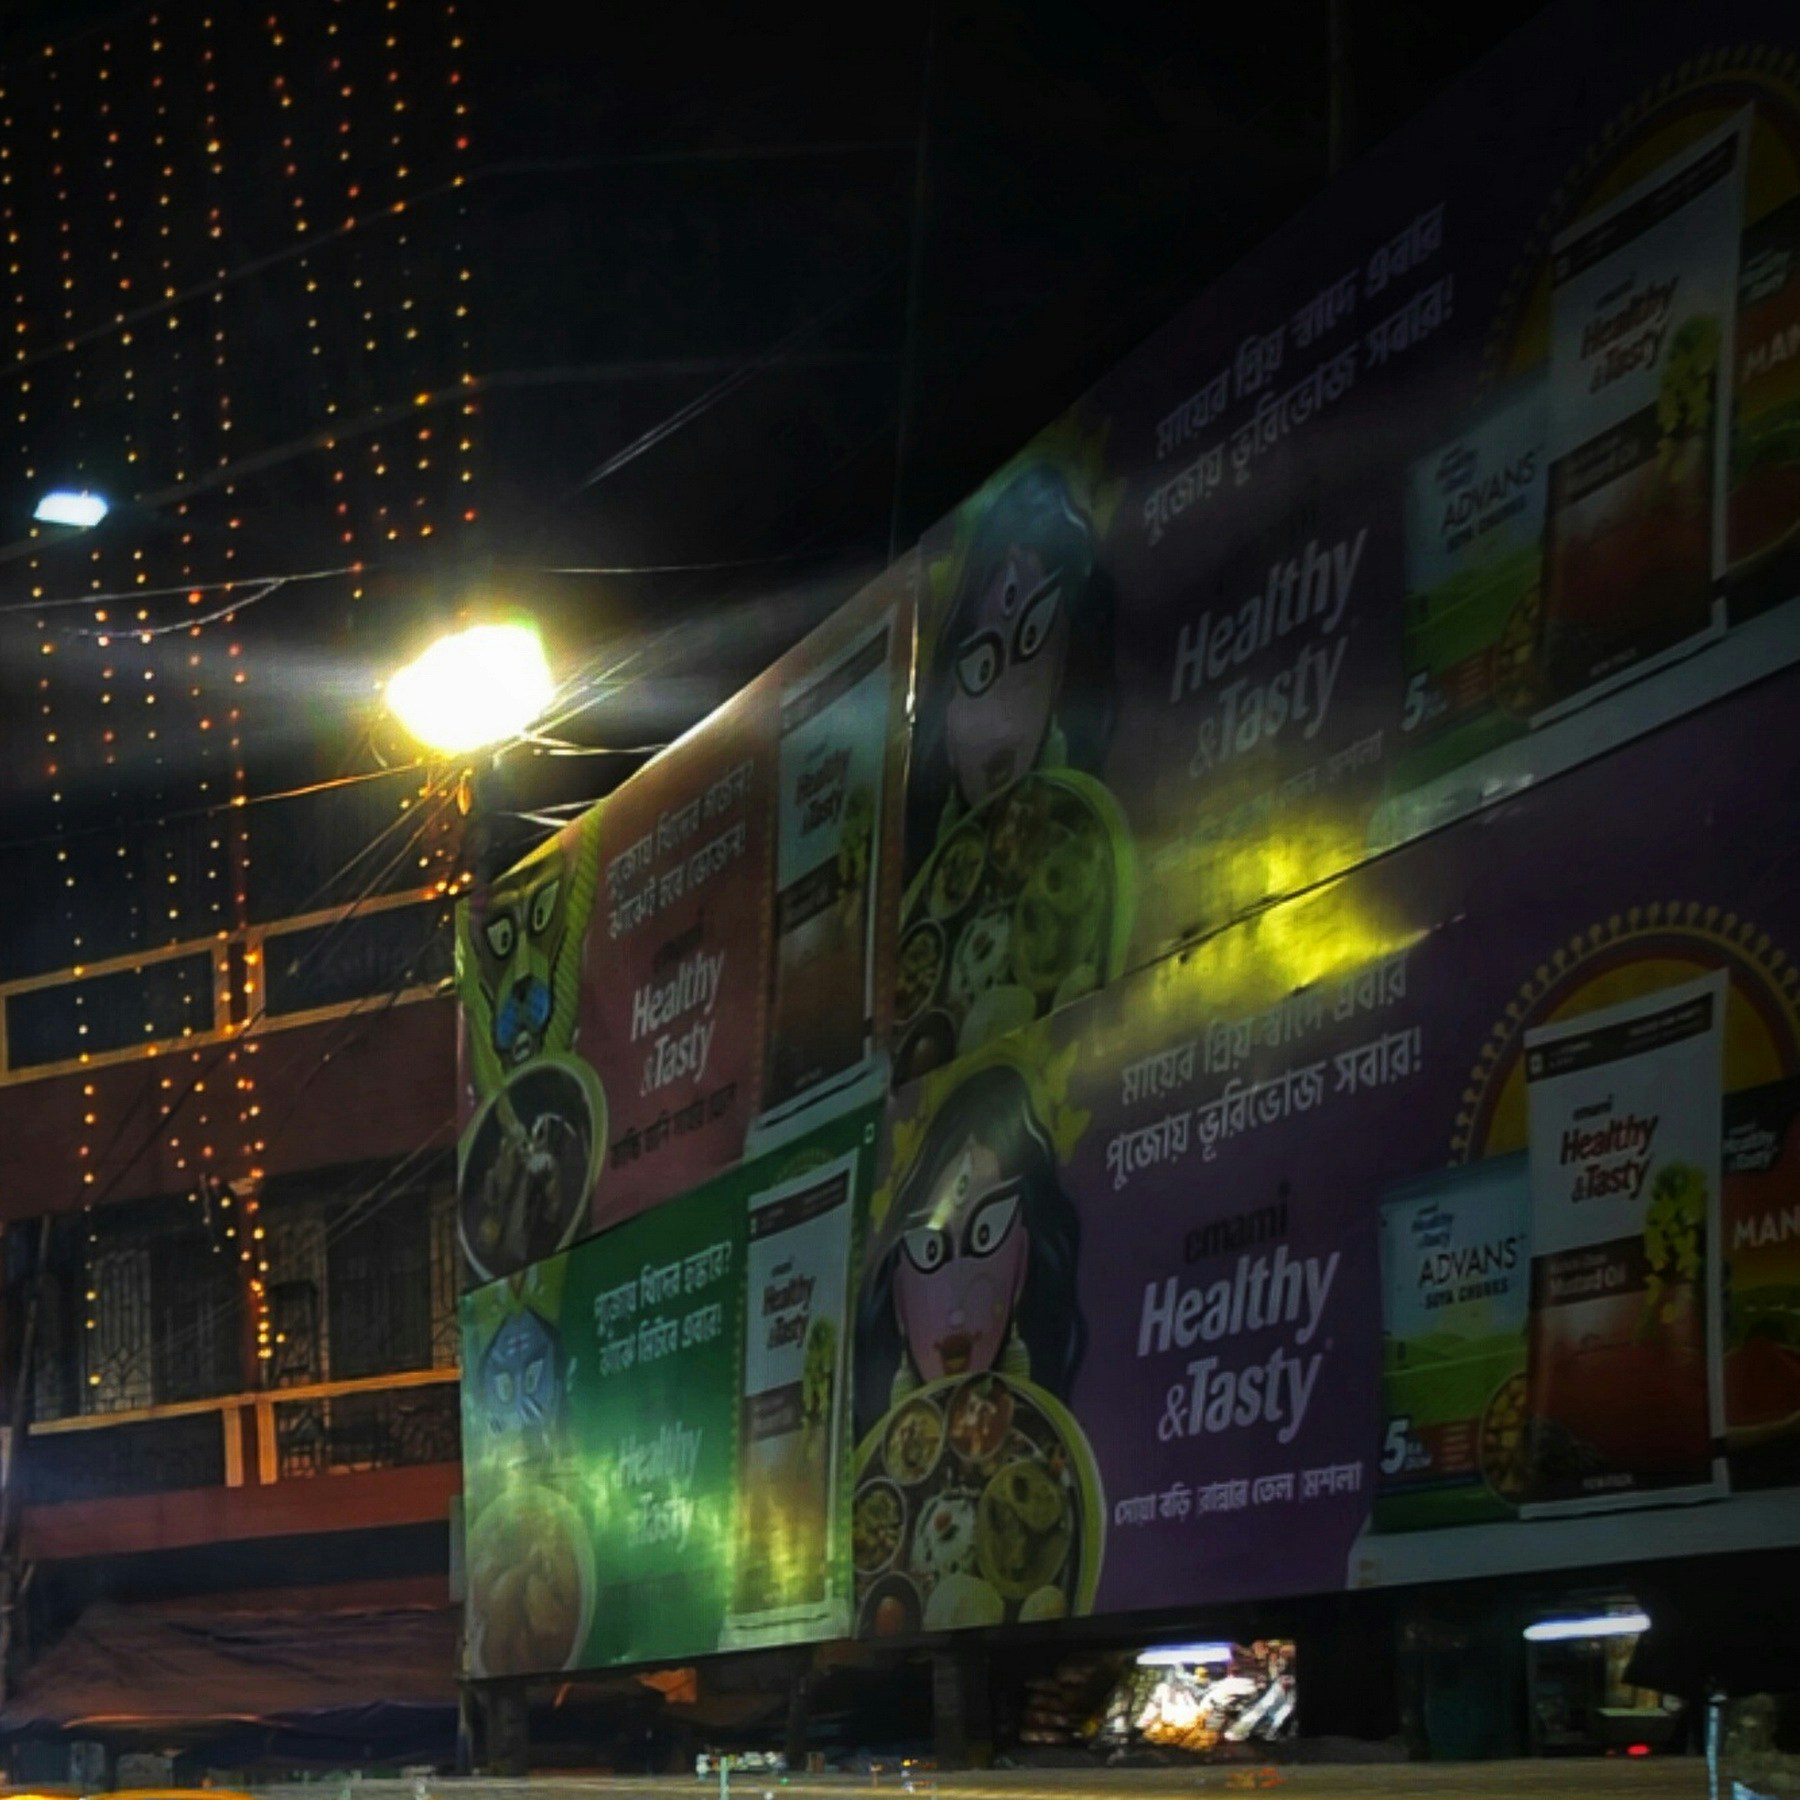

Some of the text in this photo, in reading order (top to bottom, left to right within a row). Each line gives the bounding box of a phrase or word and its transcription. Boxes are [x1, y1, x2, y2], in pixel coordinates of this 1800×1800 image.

[1156, 368, 1230, 460] মায়ের
[1234, 324, 1287, 399] প্রিয়
[1365, 201, 1446, 299] এবার
[1364, 273, 1455, 369] সবার!
[1582, 277, 1680, 361] Healthy
[1442, 450, 1537, 537] ADVANS
[1170, 527, 1368, 703] Healthy
[630, 950, 724, 1042] Healthy
[1121, 1040, 1197, 1105] মায়ের
[1202, 1018, 1252, 1075] প্রিয়
[1105, 1026, 1422, 1192] পুজোয় ভূরিভোজ সবার!
[1561, 1114, 1658, 1165] Healthy
[1184, 1181, 1290, 1264] emami
[1419, 1236, 1519, 1288] ADVANS
[1137, 1243, 1341, 1357] Healthy
[618, 1420, 703, 1491] Healthy
[1379, 1415, 1411, 1476] 5
